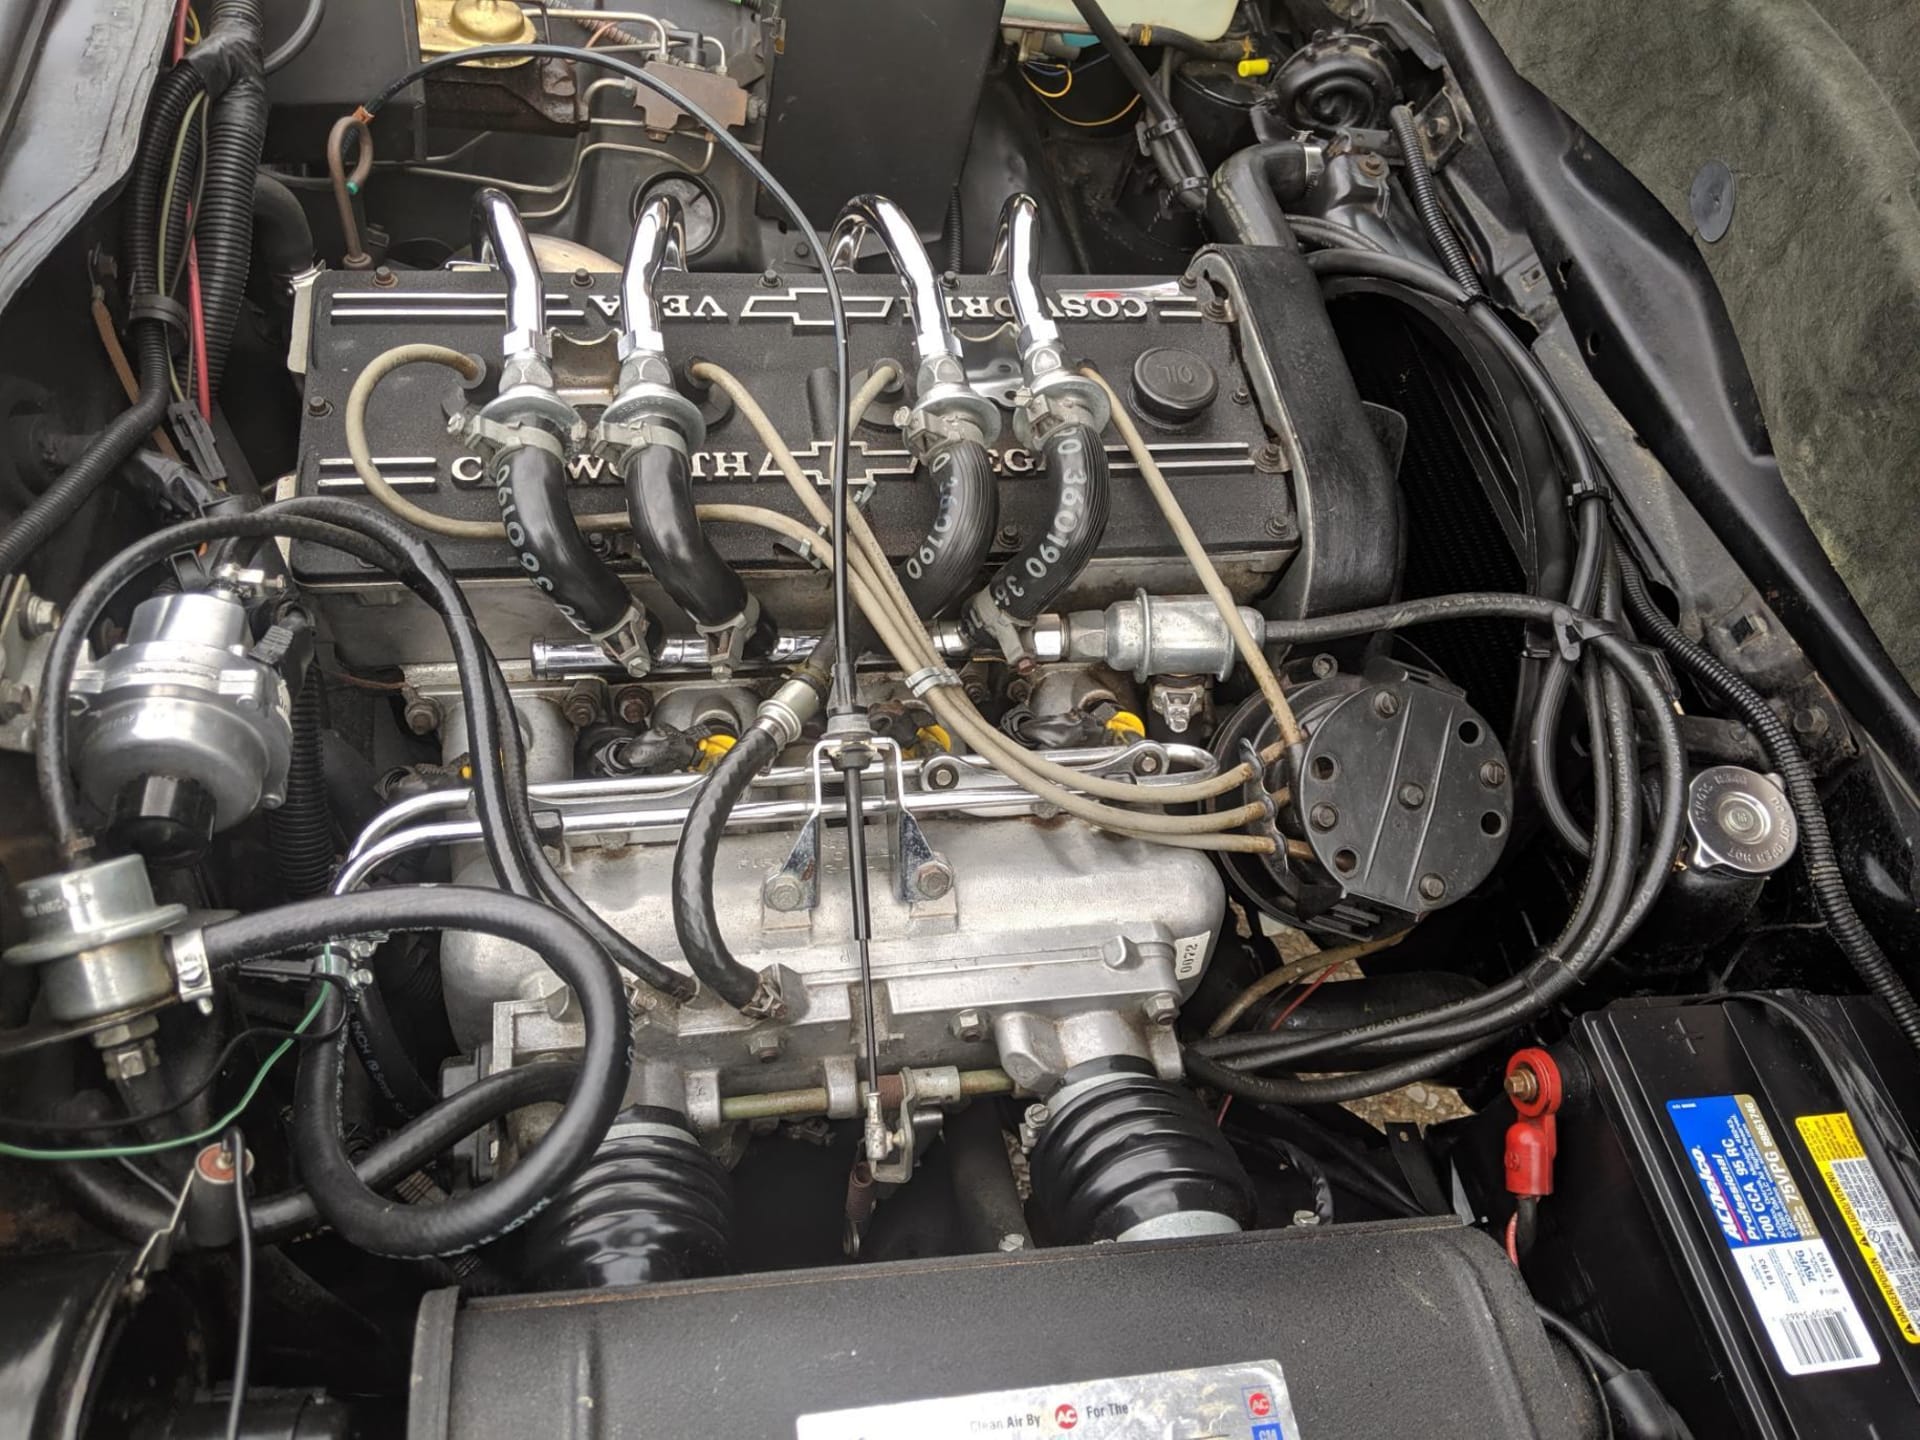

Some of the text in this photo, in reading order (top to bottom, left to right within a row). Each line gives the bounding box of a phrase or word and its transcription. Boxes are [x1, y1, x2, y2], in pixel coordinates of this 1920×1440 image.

[588, 295, 728, 317] VEA
[451, 452, 751, 480] CWTH
[1181, 943, 1198, 973] 0072
[1720, 1138, 1778, 1239] 700 CCA 95 RC
[1763, 1151, 1800, 1202] 75VPG
[1688, 1147, 1742, 1241] ACDelco
[1711, 1153, 1760, 1240] Professional
[1794, 1249, 1817, 1282] 75VPG
[1007, 1416, 1022, 1429] Air
[1026, 1414, 1041, 1428] By
[1057, 1409, 1078, 1423] AC
[1086, 1405, 1105, 1418] For
[1109, 1403, 1128, 1416] The
